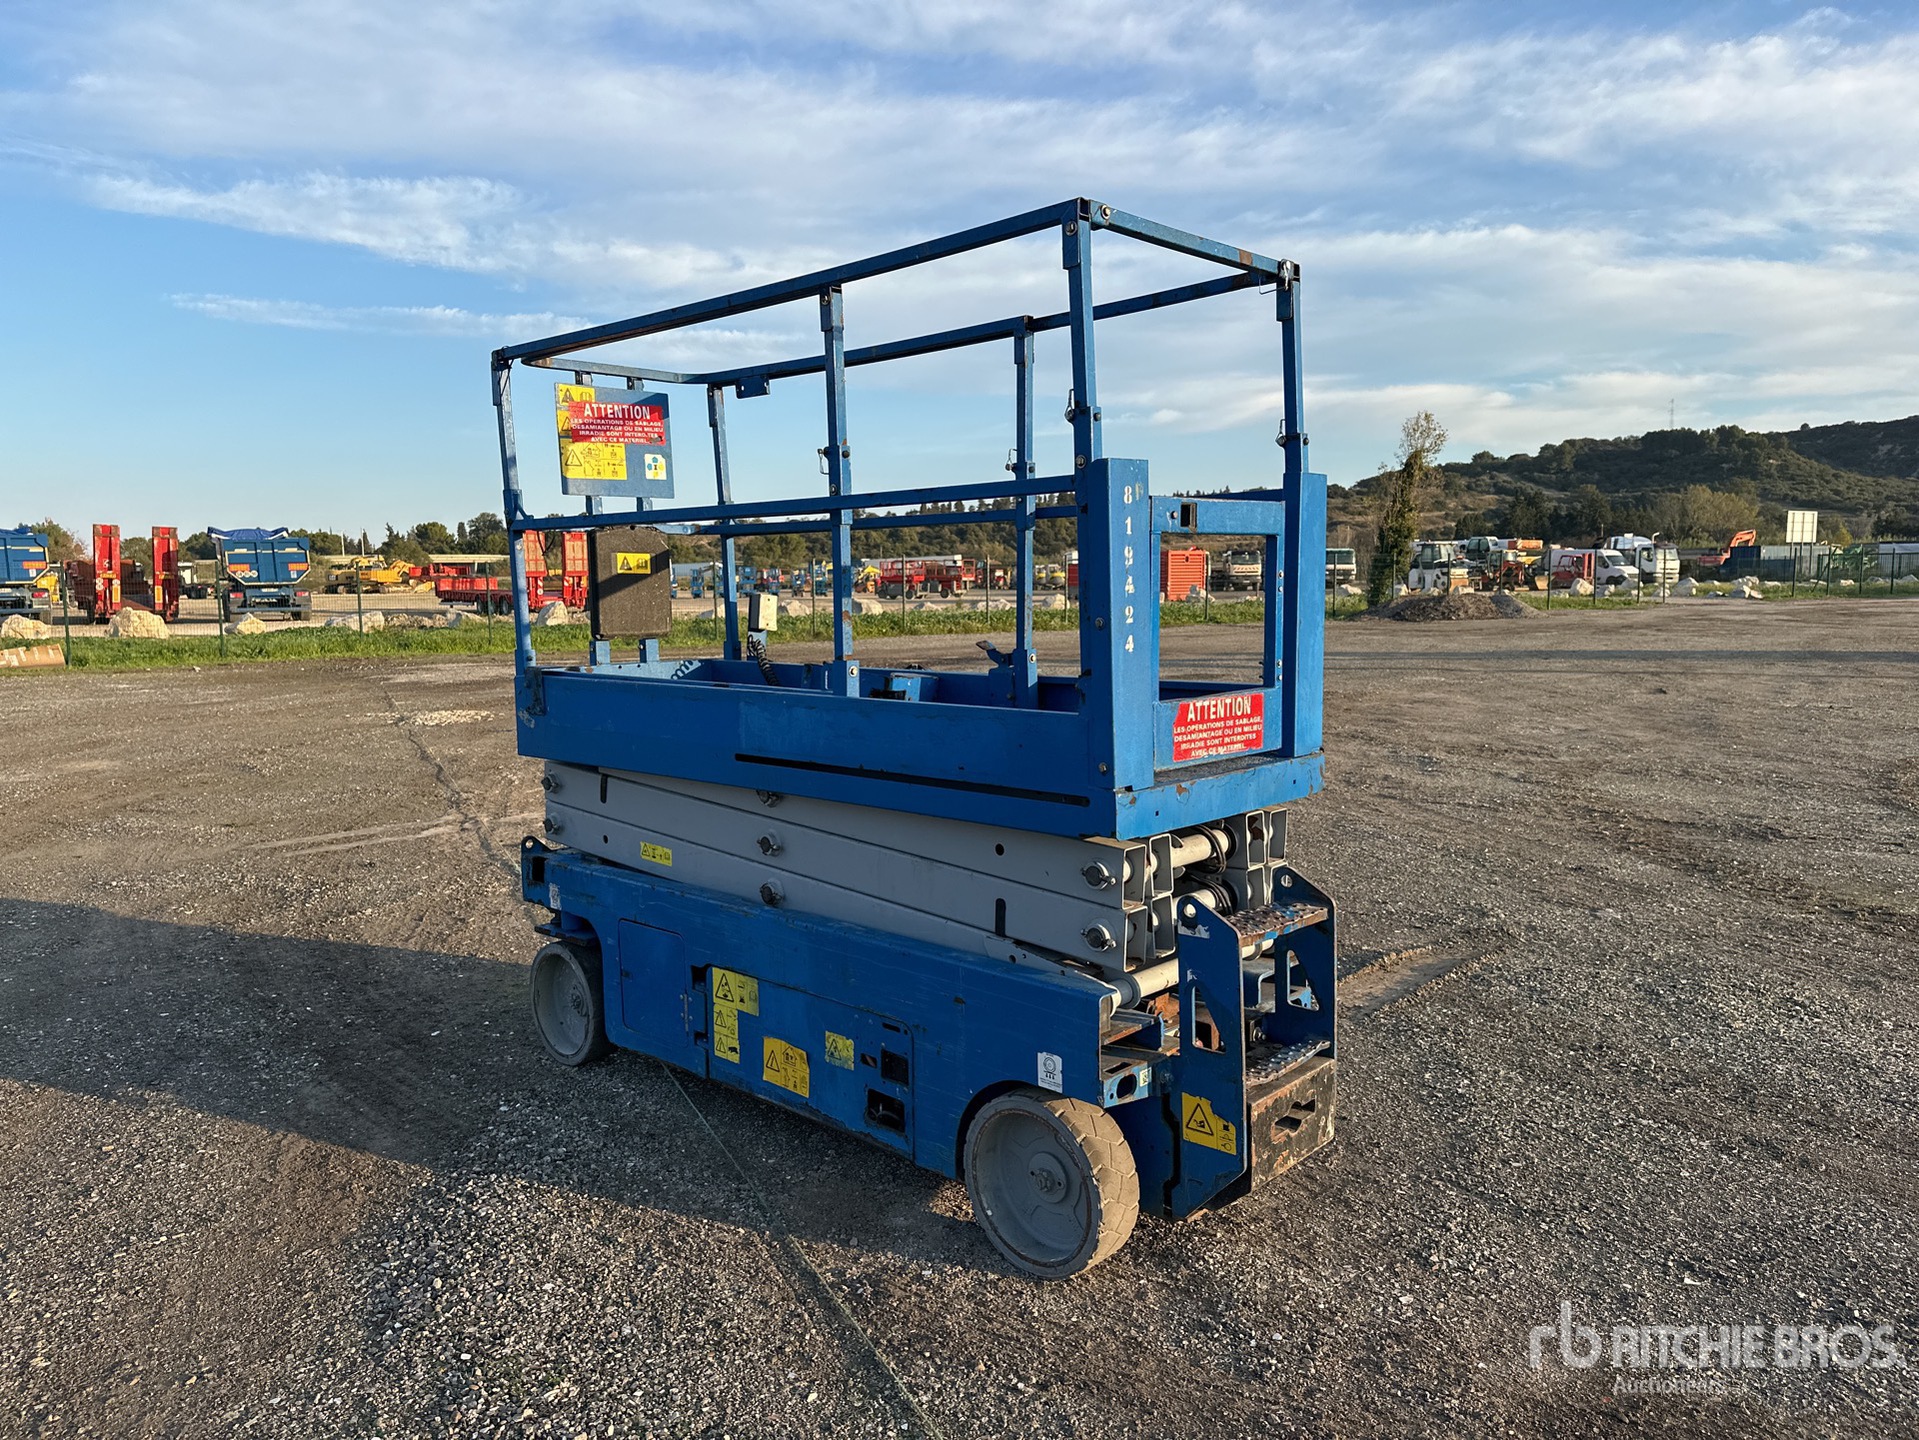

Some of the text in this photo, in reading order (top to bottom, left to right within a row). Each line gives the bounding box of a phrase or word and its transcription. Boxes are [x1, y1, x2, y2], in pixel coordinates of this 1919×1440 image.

[584, 403, 650, 420] ATTENTION
[1187, 696, 1252, 722] ATTENTION
[1174, 726, 1185, 734] LES
[1187, 721, 1225, 732] OPERATIONS
[1226, 719, 1234, 727] DE
[1224, 728, 1233, 736] OU
[1243, 724, 1262, 732] MILIEU
[1206, 738, 1222, 746] SONT
